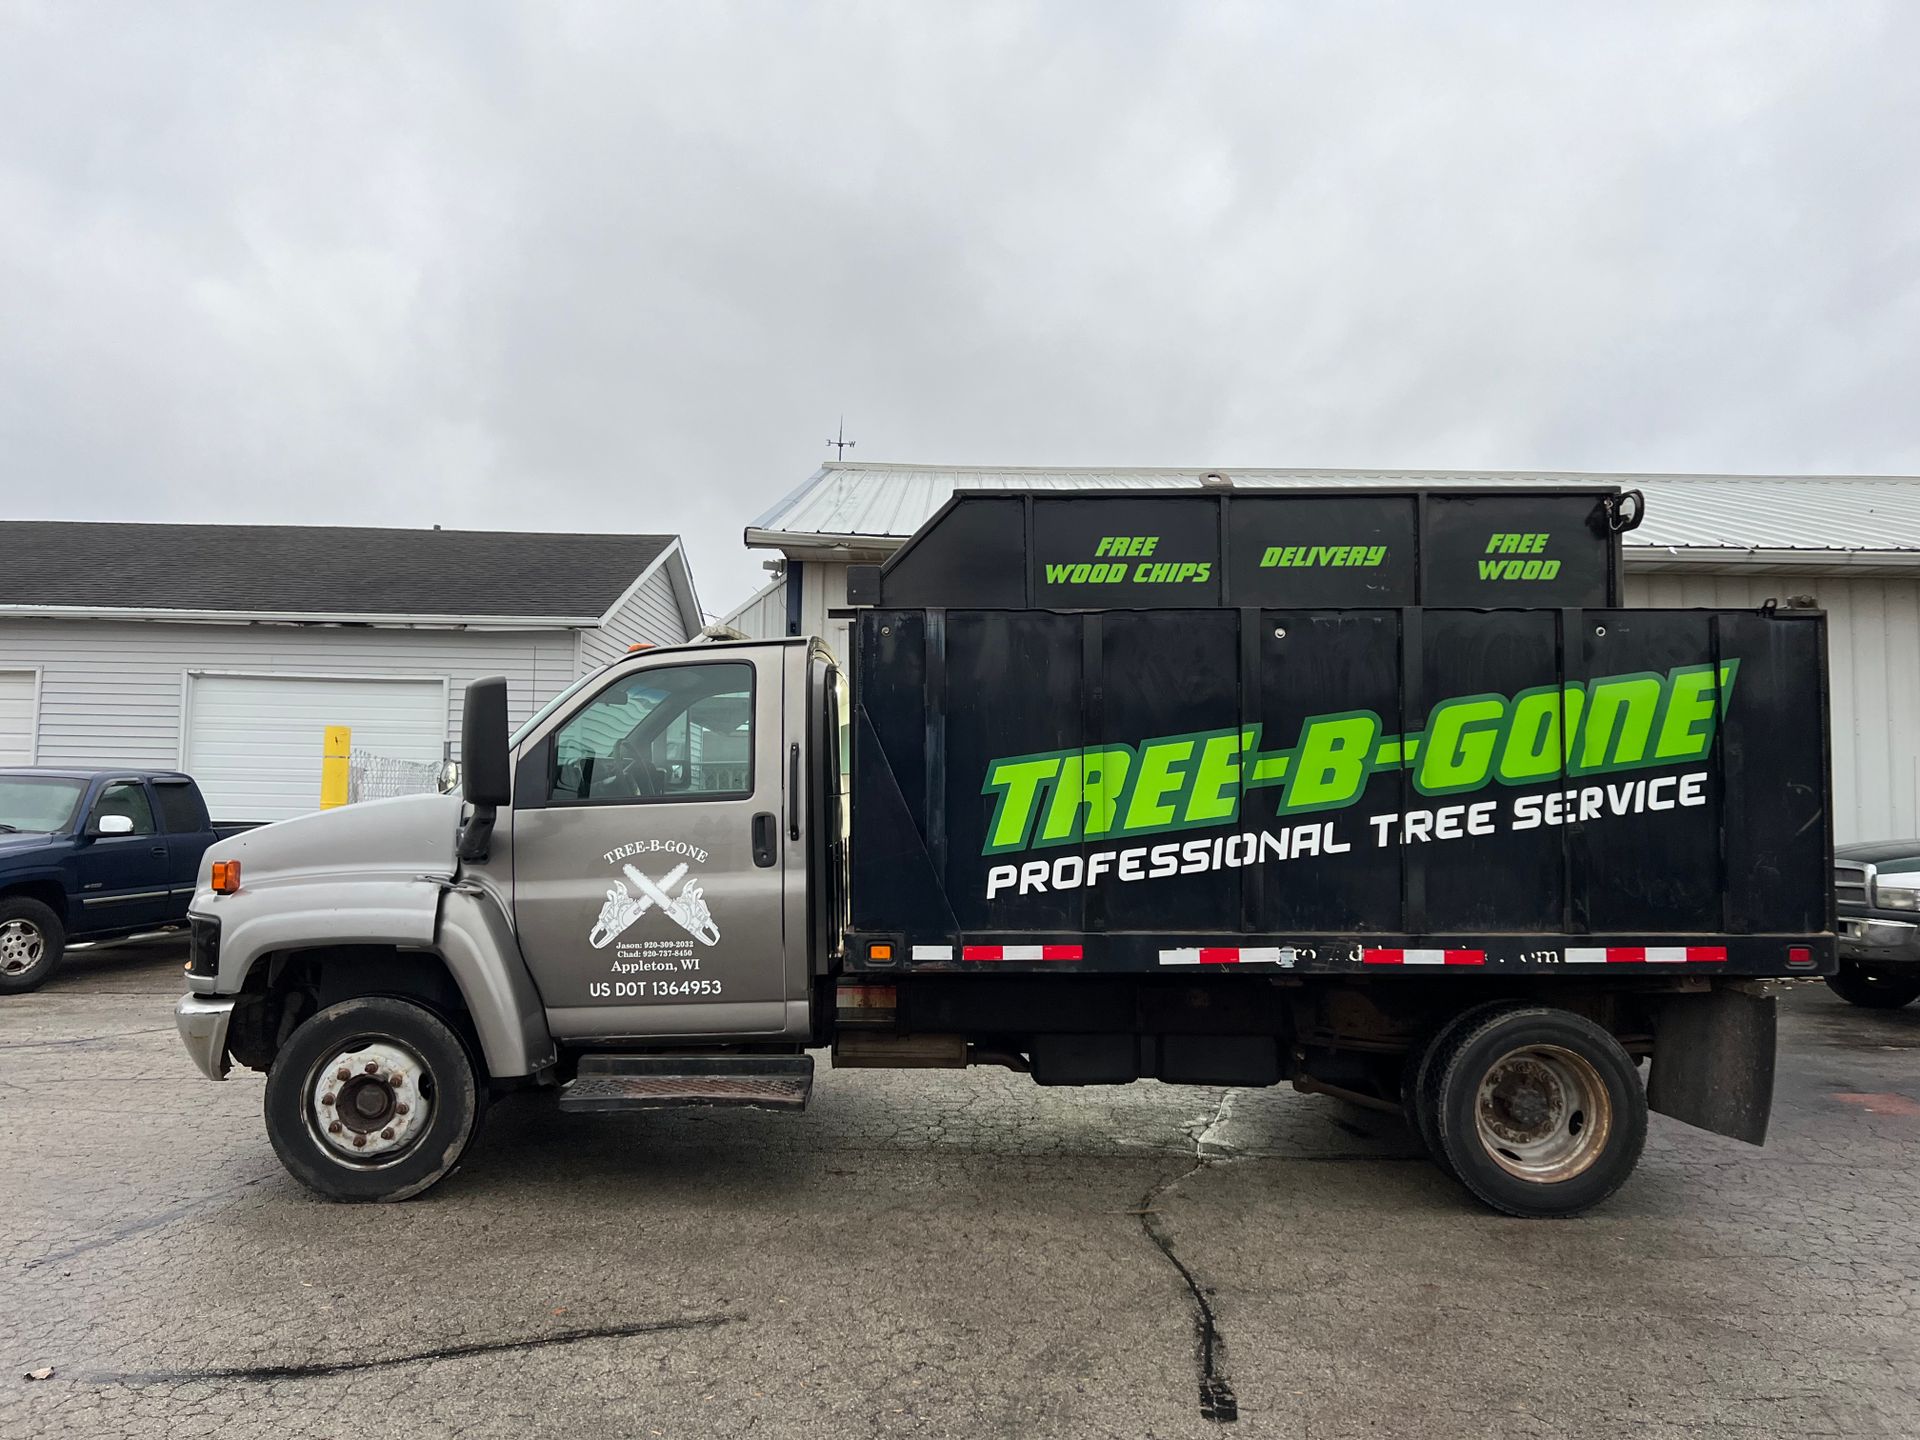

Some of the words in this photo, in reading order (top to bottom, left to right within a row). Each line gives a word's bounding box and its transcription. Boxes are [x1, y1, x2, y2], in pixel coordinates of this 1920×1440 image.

[1095, 536, 1159, 558] FREE
[1487, 533, 1550, 555] FREE
[1260, 545, 1388, 568] DELIVERY
[1045, 562, 1129, 585] WOOD
[1132, 562, 1212, 584] CHIPS
[1478, 559, 1561, 581] WOOD
[980, 659, 1740, 855] TREE-B-GONE
[986, 821, 1351, 900] PROFESSIONAL
[1369, 800, 1497, 848] TREE
[1512, 772, 1708, 831] SERVICE
[603, 839, 709, 864] TREE-B-GONE
[615, 941, 643, 950] Jason:
[616, 950, 642, 958] Chad:
[610, 959, 678, 974] Appleton,
[680, 958, 701, 970] WI
[589, 982, 611, 997] US
[615, 981, 647, 997] DOT
[652, 980, 722, 996] 1364953
